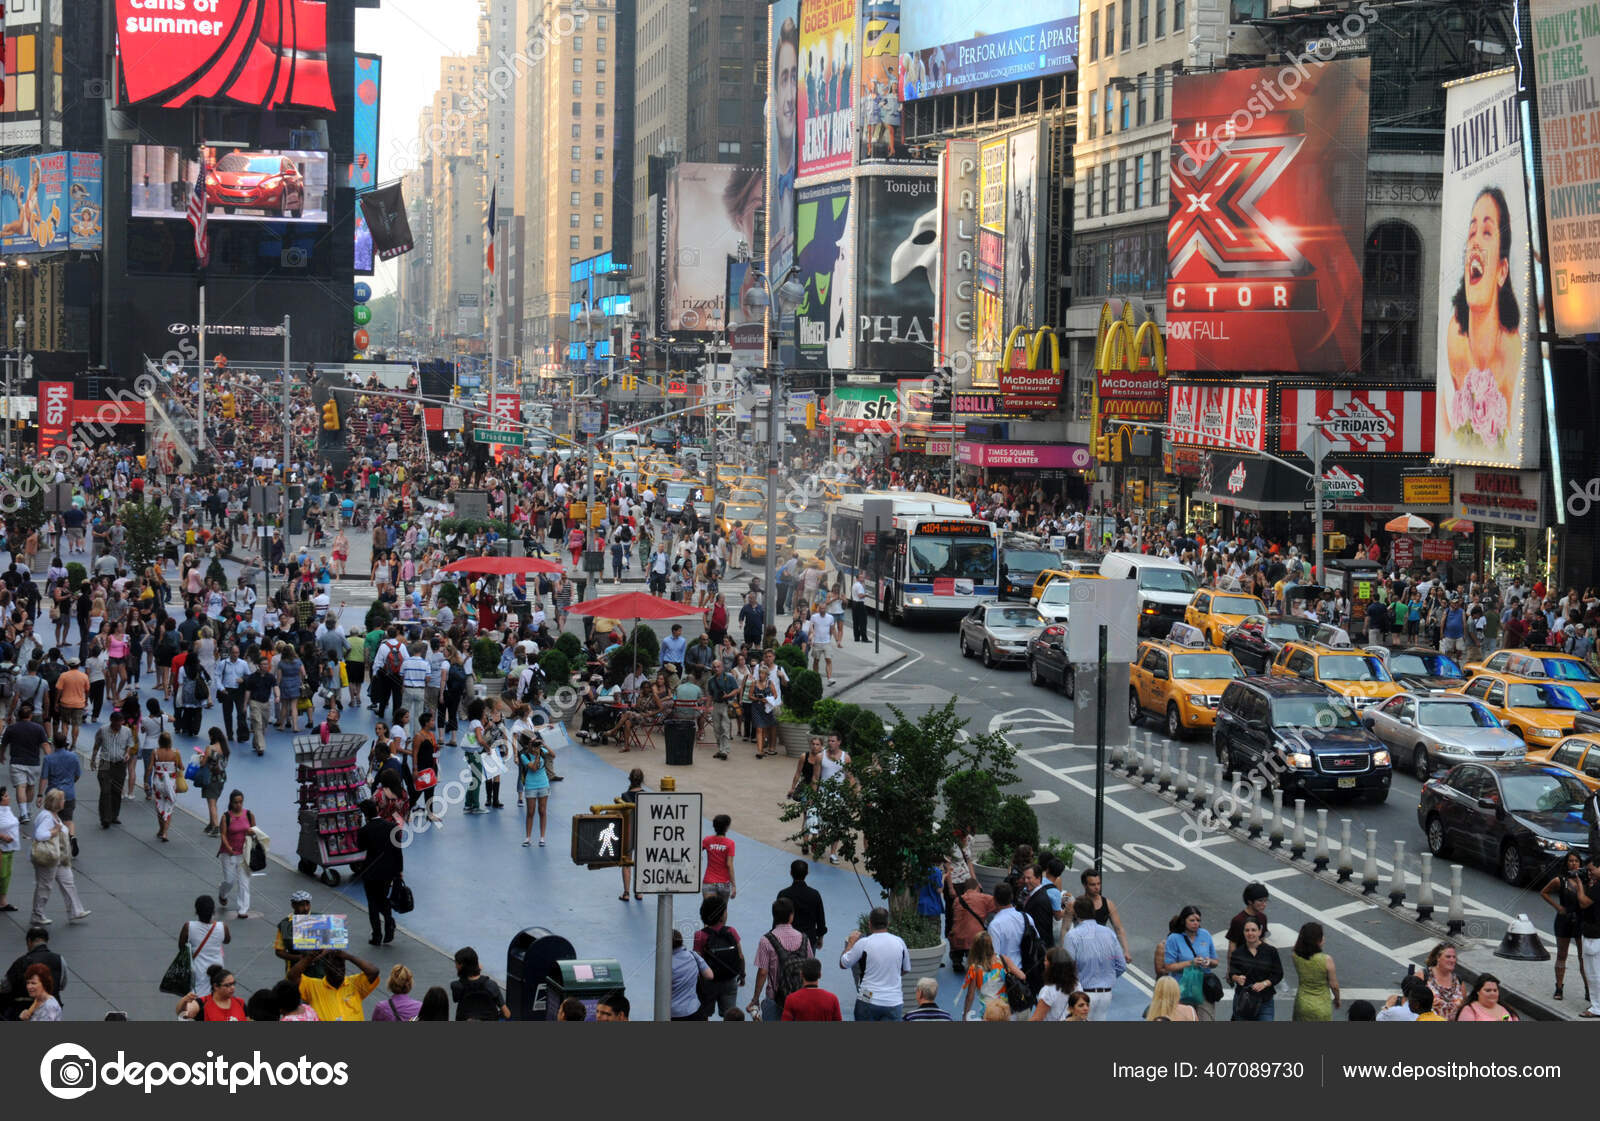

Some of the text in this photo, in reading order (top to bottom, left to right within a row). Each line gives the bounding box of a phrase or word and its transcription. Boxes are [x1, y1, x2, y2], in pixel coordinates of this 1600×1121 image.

[126, 17, 223, 36] summer
[804, 10, 829, 34] GOES
[1536, 9, 1580, 51] YOU'VE
[959, 34, 1035, 67] PERFORMANCE
[1538, 44, 1589, 84] IT HERE.
[1541, 83, 1564, 119] BUT
[1566, 76, 1600, 113] WILL
[802, 113, 832, 163] JERSEY
[1451, 105, 1499, 175] MAMMA
[1544, 118, 1569, 153] YOU
[1570, 114, 1588, 147] BE
[1546, 154, 1563, 186] TO
[886, 179, 930, 196] Tonight
[1552, 223, 1566, 242] ASK
[1567, 220, 1587, 241] TEAM
[956, 158, 976, 331] PALACE
[682, 294, 724, 311] rizzoli
[191, 325, 245, 335] HUNDAI
[860, 314, 936, 345] PHA
[1193, 320, 1230, 340] FALL
[1002, 376, 1061, 386] McDonald's
[1101, 379, 1167, 389] McDonald's
[47, 386, 68, 425] tkts
[481, 432, 518, 444] Broadway
[932, 443, 950, 454] BEST
[988, 448, 1035, 457] TIMES SQUARE
[988, 456, 1039, 464] VISITOR CENTER
[650, 804, 689, 820] WAIT
[653, 826, 685, 841] FOR
[645, 848, 691, 863] WALK
[642, 869, 692, 884] SIGNAL
